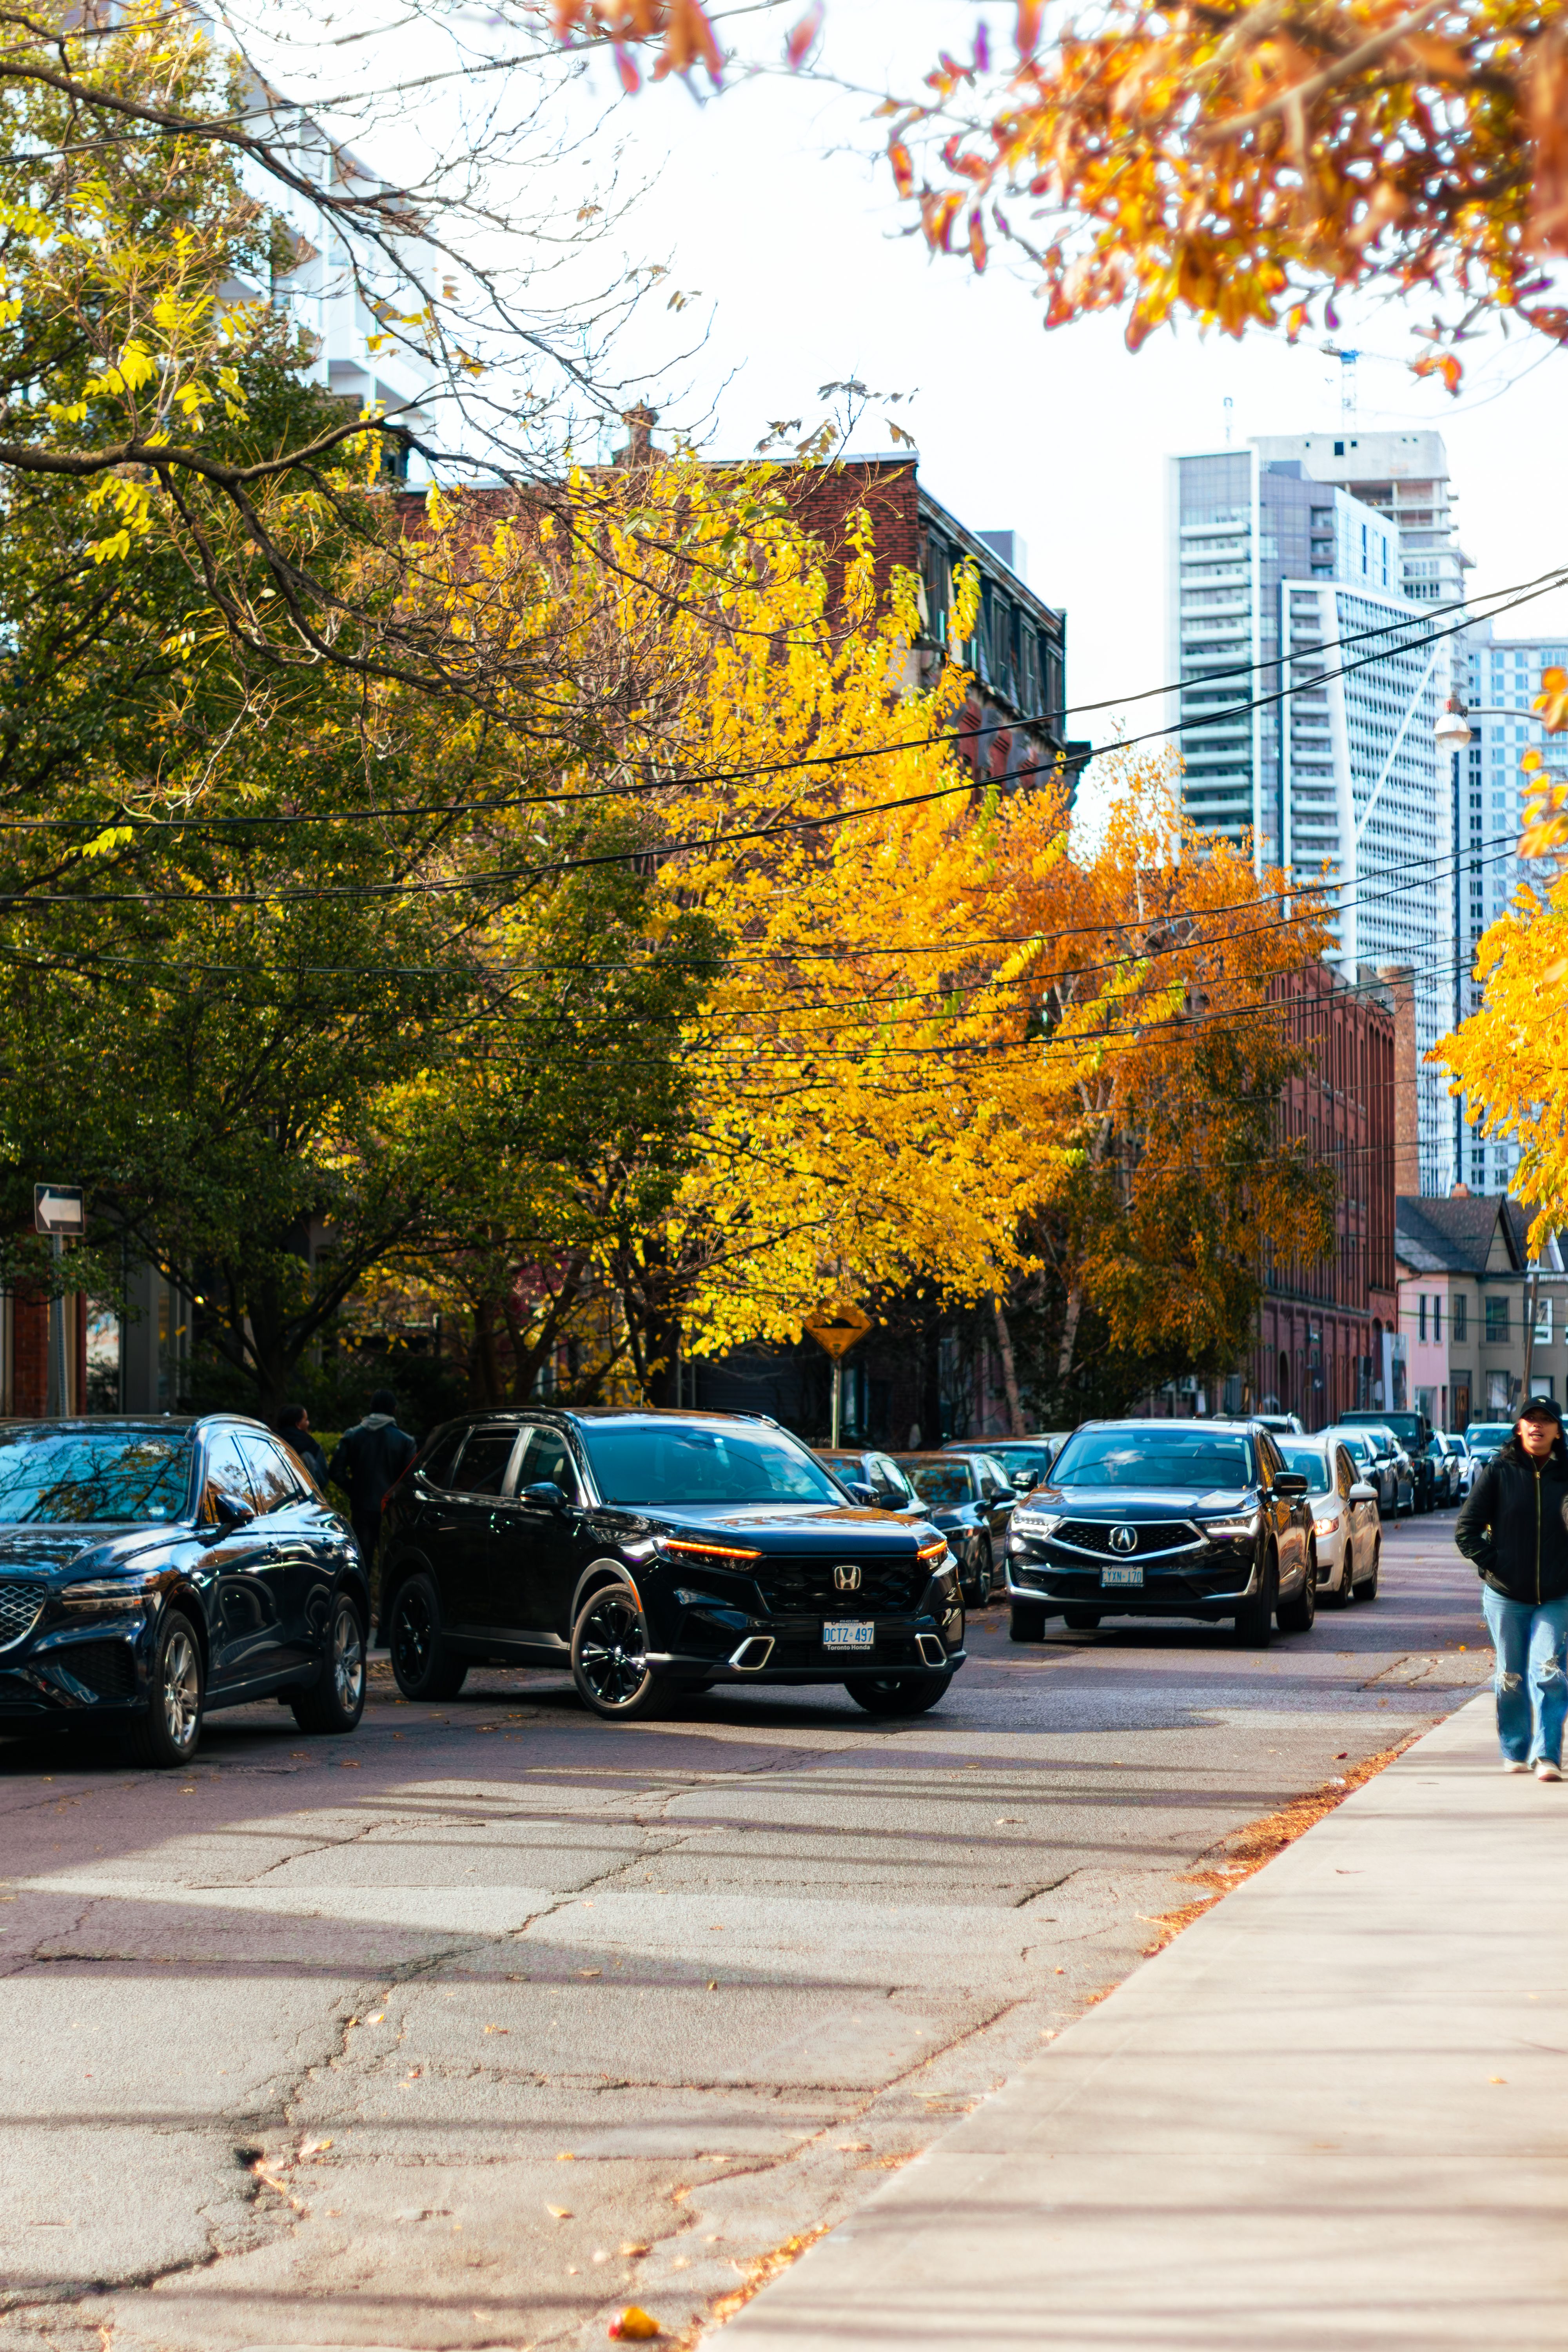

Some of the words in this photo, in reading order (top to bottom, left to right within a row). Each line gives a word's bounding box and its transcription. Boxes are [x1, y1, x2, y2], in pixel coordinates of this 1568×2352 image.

[1102, 1571, 1122, 1581] CYXN
[1128, 1571, 1142, 1582] 170
[824, 1628, 849, 1642] DCTZ
[855, 1628, 873, 1642] 497
